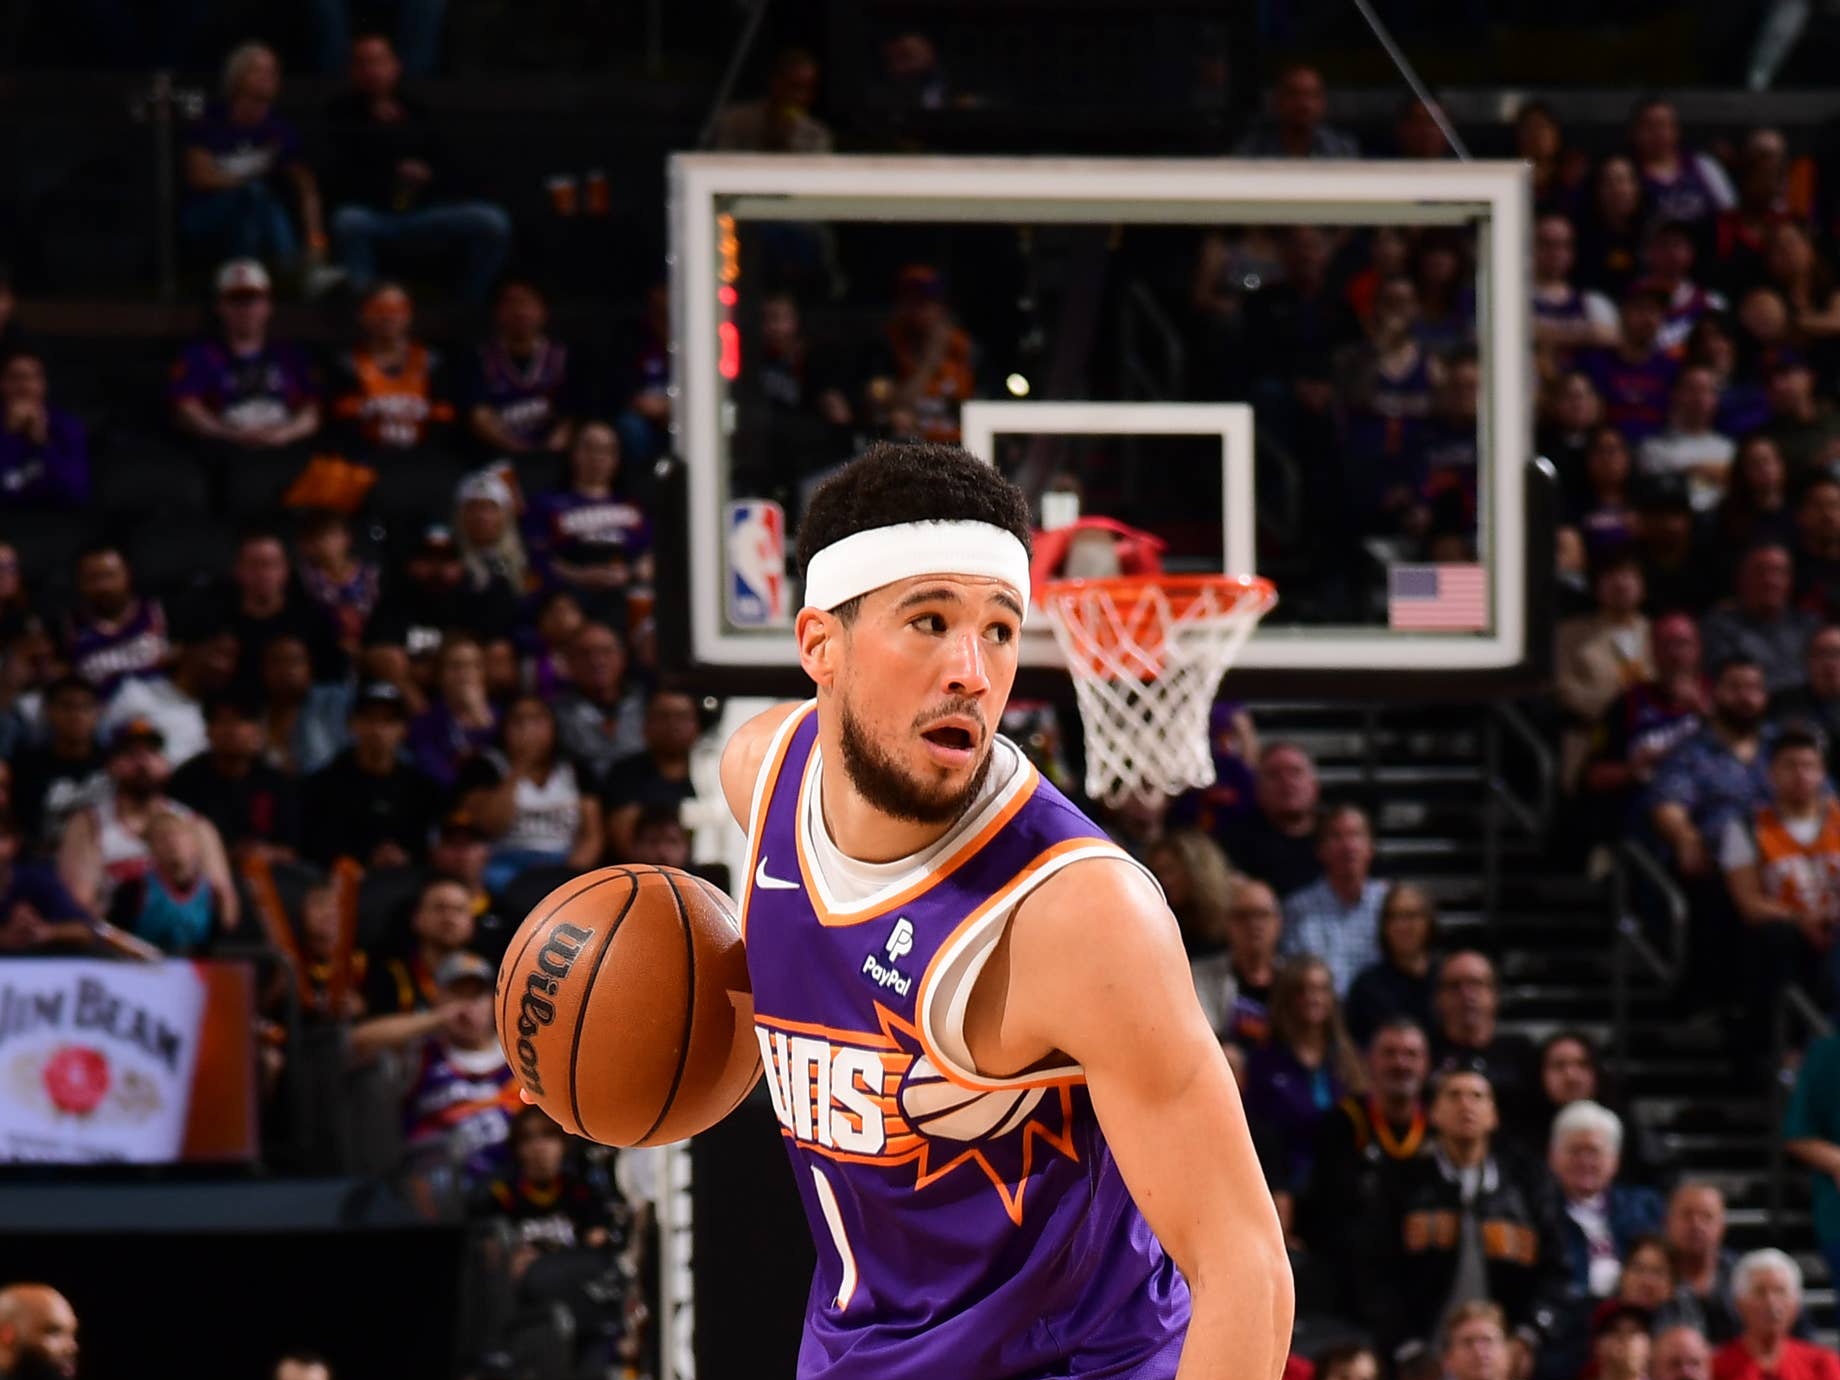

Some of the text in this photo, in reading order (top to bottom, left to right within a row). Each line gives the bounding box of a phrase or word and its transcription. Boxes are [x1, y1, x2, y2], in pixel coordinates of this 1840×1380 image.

[517, 921, 596, 1096] Wilson
[862, 954, 912, 997] PayPal
[754, 1026, 885, 1155] UNS
